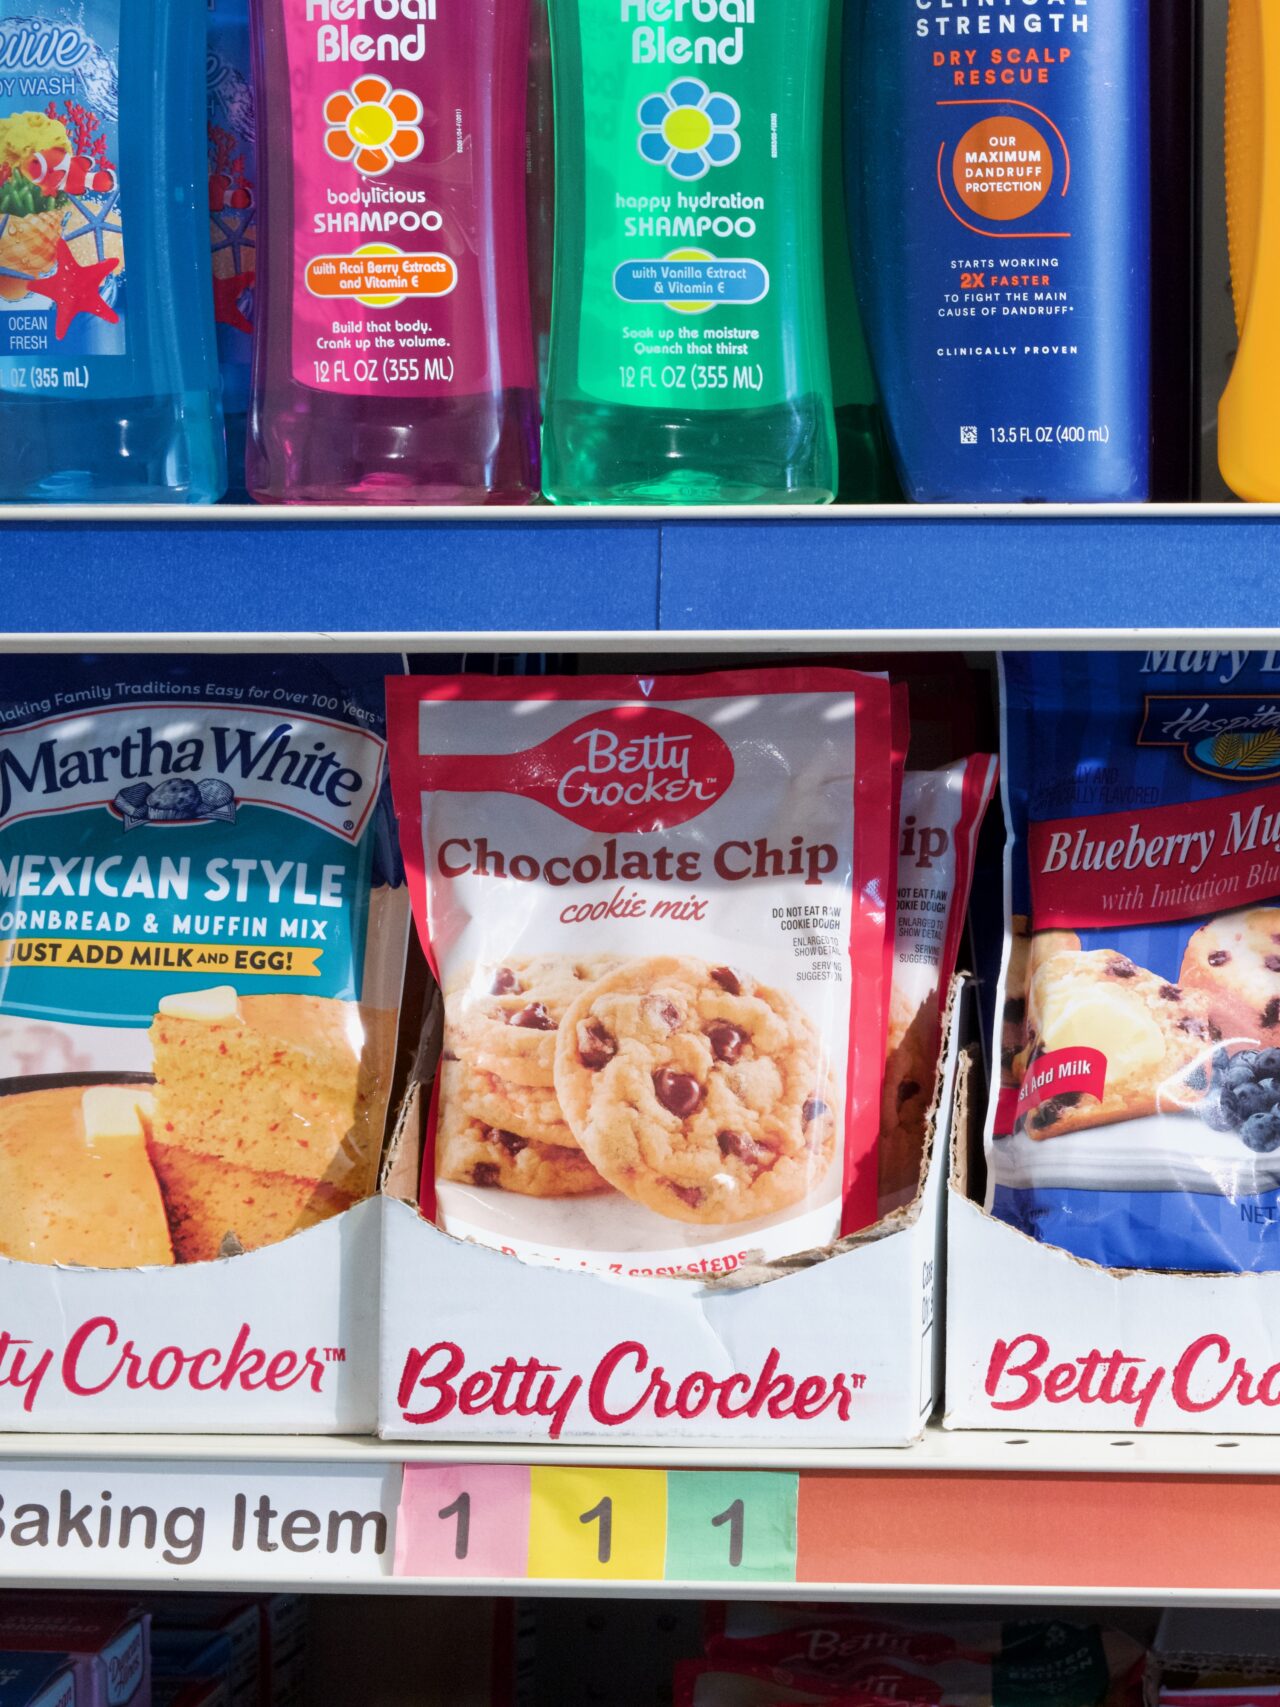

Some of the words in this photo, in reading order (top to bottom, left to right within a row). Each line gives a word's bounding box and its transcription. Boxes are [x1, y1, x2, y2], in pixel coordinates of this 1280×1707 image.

[916, 14, 1088, 37] STRENGTH
[0, 22, 88, 67] vive
[317, 24, 426, 62] Blend
[632, 26, 743, 65] Blend
[933, 50, 977, 67] DRY
[991, 48, 1071, 64] SCALP
[19, 78, 75, 95] WASH
[954, 68, 1049, 86] RESCUE
[989, 136, 1016, 147] OUR
[965, 150, 1041, 163] MAXIMUM
[965, 167, 1042, 178] DANDRUFF
[327, 187, 426, 208] bodylicious
[965, 181, 1042, 193] PROTECTION
[615, 192, 671, 212] happy
[677, 192, 764, 212] hydration
[313, 211, 443, 233] SHAMPOO
[624, 216, 756, 238] SHAMPOO
[313, 262, 336, 275] with
[339, 261, 364, 274] Acai
[367, 261, 399, 276] Berry
[402, 260, 446, 273] Extracts
[951, 259, 994, 269] STARTS
[1000, 258, 1059, 268] WORKING
[339, 276, 361, 289] and
[364, 276, 408, 288] Vitamin
[960, 273, 985, 289] 2X
[991, 275, 1050, 286] FASTER
[8, 317, 47, 331] OCEAN
[622, 327, 654, 339] Soak
[658, 329, 674, 341] up
[678, 326, 699, 339] the
[703, 327, 760, 340] moisture
[10, 336, 47, 349] FRESH
[634, 342, 683, 355] Quench
[687, 342, 713, 355] that
[716, 342, 749, 355] thirst
[936, 347, 1017, 356] CLINICALLY
[1024, 346, 1078, 355] PROVEN
[990, 427, 1017, 442] 13.5
[1020, 427, 1033, 442] FL
[1035, 427, 1053, 442] OZ
[1056, 425, 1085, 444] (400
[1088, 425, 1109, 443] mL)
[54, 685, 112, 706] Family
[115, 682, 200, 695] Traditions
[205, 684, 244, 698] Easy
[248, 686, 270, 700] for
[272, 688, 308, 704] Over
[311, 694, 338, 710] 100
[573, 728, 693, 779] Betty
[0, 726, 205, 818] Martha
[210, 724, 363, 808] White
[1041, 823, 1216, 874] Blueberry
[438, 837, 702, 886] Chocolate
[713, 836, 838, 885] Chip
[0, 854, 191, 901] MEXICAN
[204, 857, 346, 908] STYLE
[1101, 884, 1145, 912] with
[1149, 874, 1239, 909] Imitation
[560, 886, 646, 924] cookie
[650, 895, 709, 922] mix
[0, 910, 131, 932] ORNBREAD
[143, 913, 159, 934] &
[172, 914, 267, 937] MUFFIN
[280, 919, 328, 940] MIX
[6, 943, 62, 963] JUST
[67, 944, 123, 965] ADD
[130, 946, 194, 967] MILK
[197, 952, 229, 964] AND
[235, 950, 293, 971] EGG!
[397, 1340, 583, 1440] Betty
[985, 1333, 1165, 1428] Betty
[0, 1489, 206, 1566] aking
[232, 1493, 388, 1555] Item
[438, 1492, 471, 1560] 1
[579, 1496, 613, 1564] 1
[711, 1499, 745, 1568] 1
